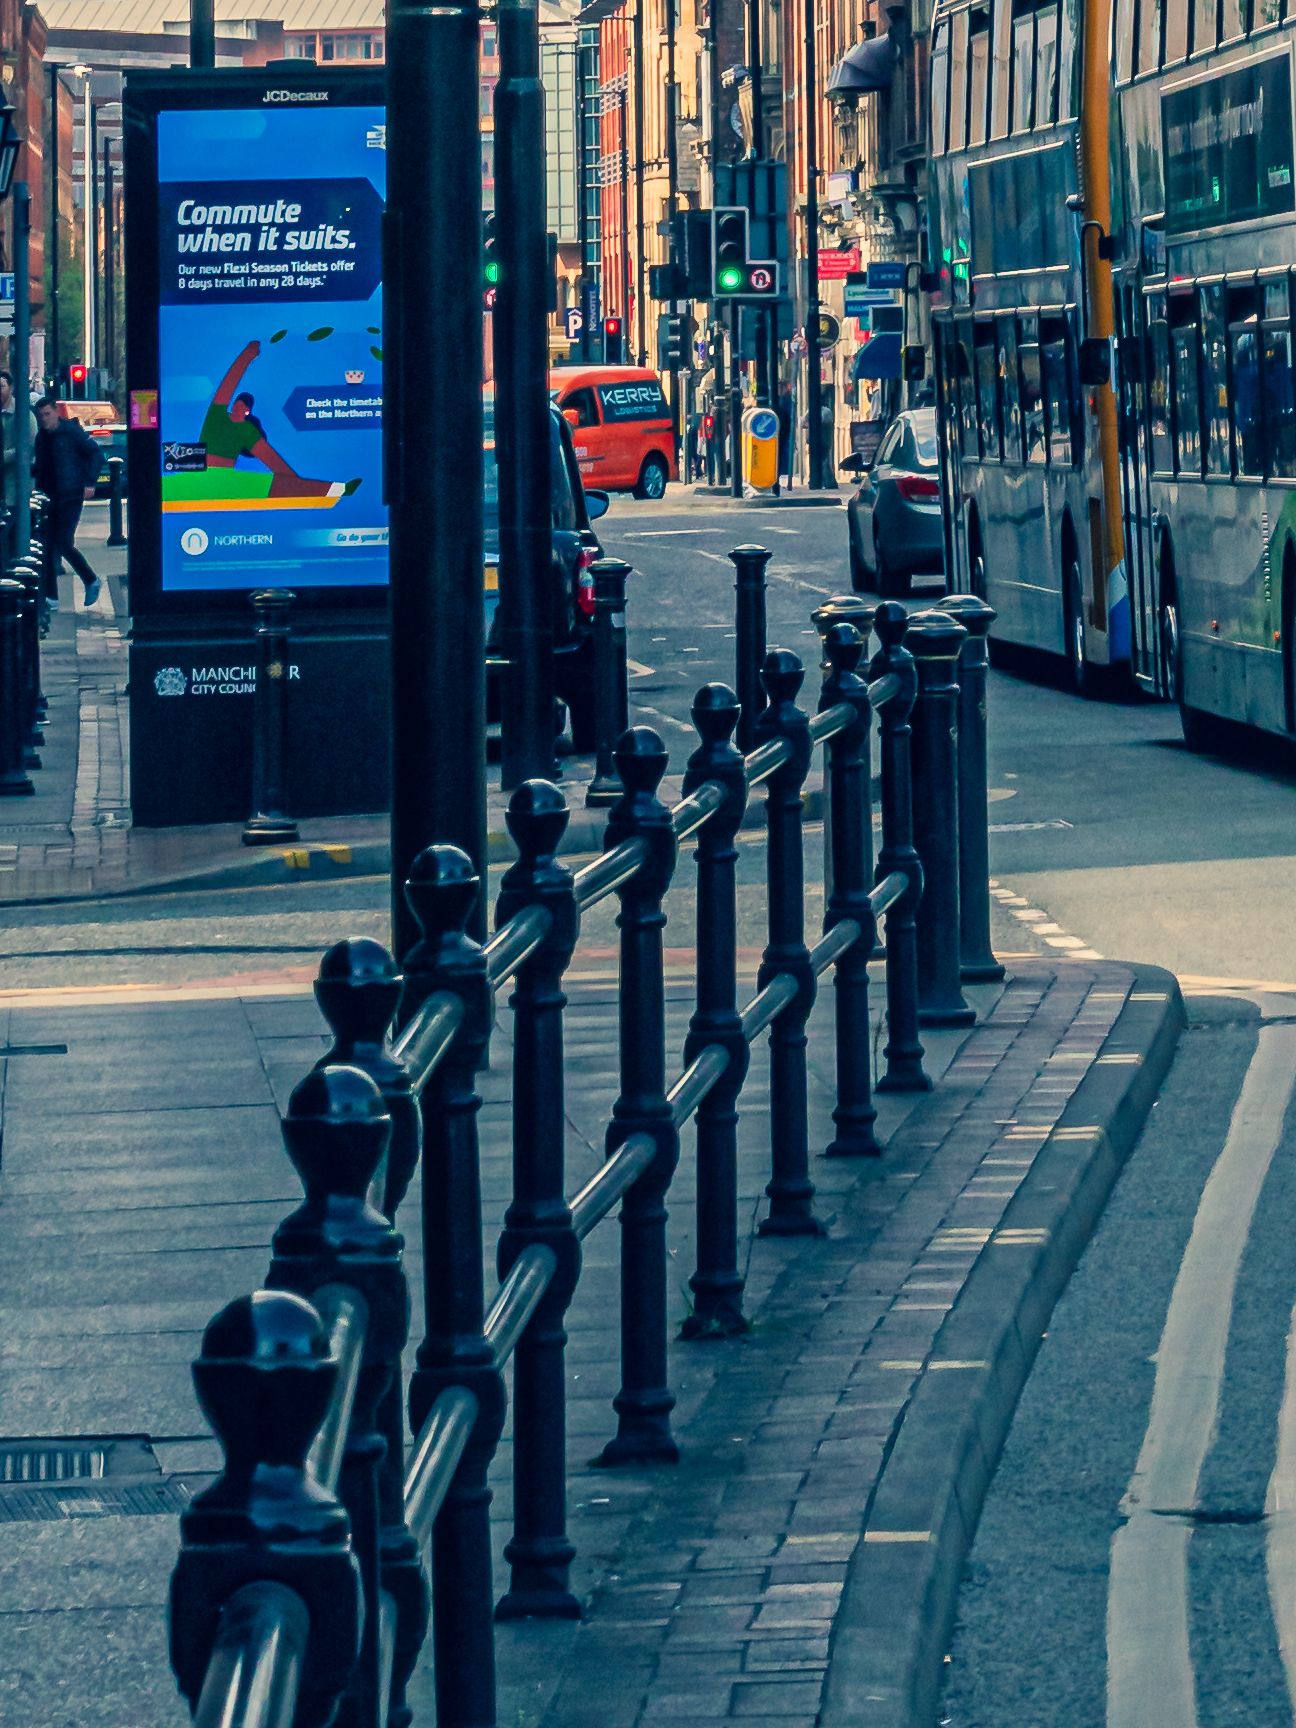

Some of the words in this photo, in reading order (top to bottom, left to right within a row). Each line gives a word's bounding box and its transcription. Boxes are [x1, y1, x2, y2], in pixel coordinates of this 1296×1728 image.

[263, 91, 328, 102] JCDecaux
[178, 200, 302, 226] Commute
[178, 228, 252, 253] when
[258, 226, 280, 251] it
[283, 224, 356, 250] suits.
[178, 264, 196, 275] Our
[199, 265, 222, 275] new
[224, 263, 250, 274] Flexi
[252, 262, 288, 273] Season
[291, 261, 328, 272] Tickets
[331, 260, 356, 271] offer
[178, 278, 185, 289] 8
[188, 277, 213, 291] days
[215, 277, 245, 288] travel
[247, 277, 257, 287] in
[260, 278, 279, 290] any
[281, 276, 295, 287] 28
[569, 315, 583, 338] P
[307, 398, 332, 408] Check
[334, 398, 348, 408] the
[602, 387, 662, 406] KERRY
[306, 411, 317, 419] on
[319, 409, 332, 419] the
[335, 409, 373, 418] Northern
[214, 535, 273, 546] NORTHERN
[337, 533, 347, 542] Go
[349, 533, 359, 542] do
[361, 533, 380, 544] your
[192, 665, 301, 681] MANCHR
[192, 685, 216, 695] CITY
